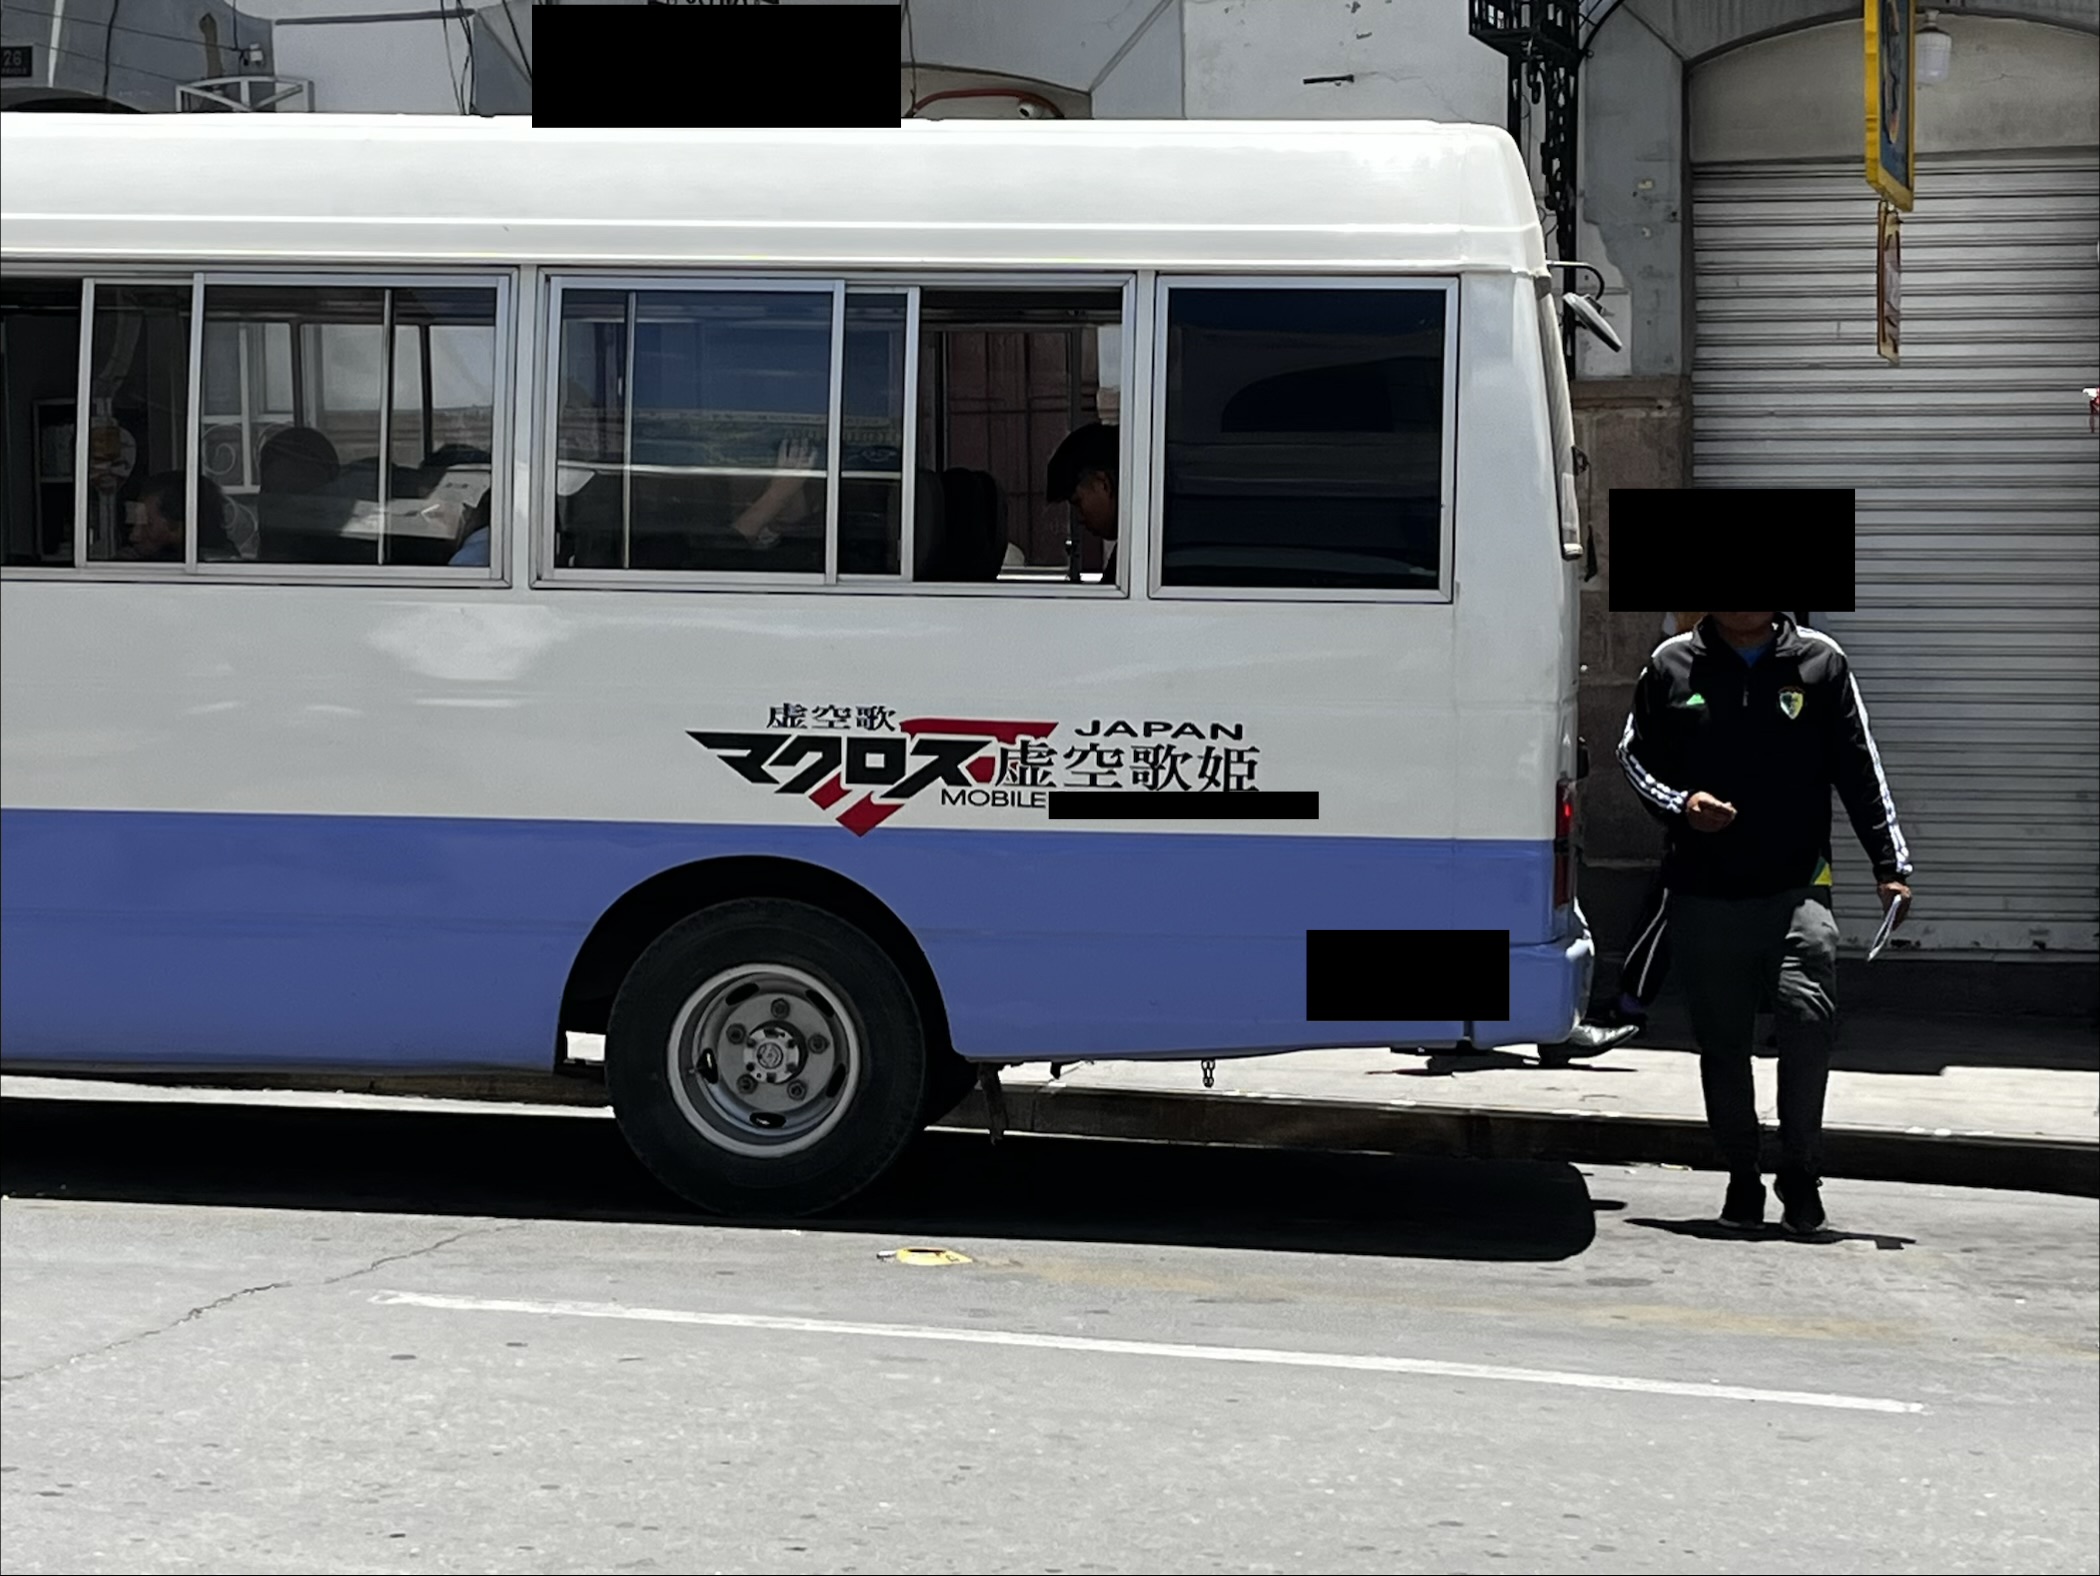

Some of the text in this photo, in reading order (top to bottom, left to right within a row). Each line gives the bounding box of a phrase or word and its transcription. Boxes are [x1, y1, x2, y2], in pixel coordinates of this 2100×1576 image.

[766, 702, 896, 731] 虚空歌
[1074, 720, 1243, 740] JAPAN
[685, 730, 993, 800] マクロス
[995, 740, 1260, 791] 虚空歌姫
[941, 788, 1047, 808] MOBILE
